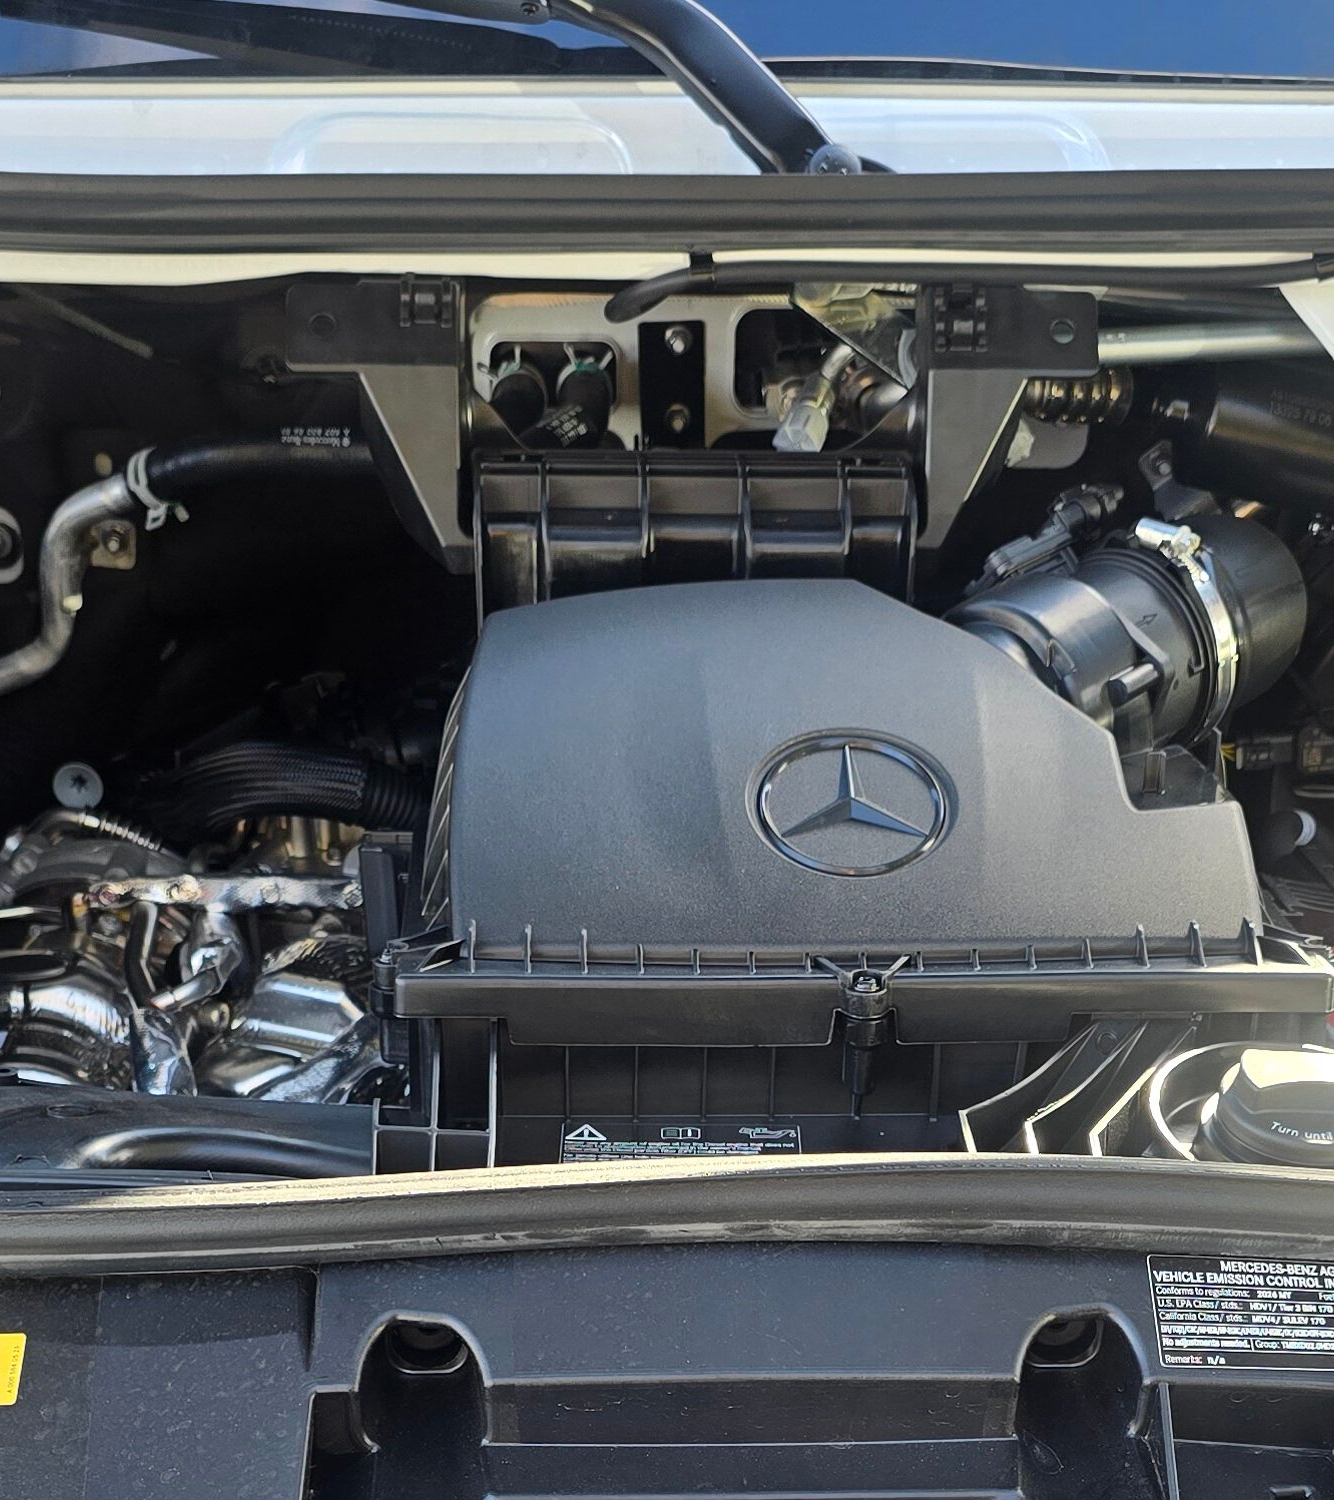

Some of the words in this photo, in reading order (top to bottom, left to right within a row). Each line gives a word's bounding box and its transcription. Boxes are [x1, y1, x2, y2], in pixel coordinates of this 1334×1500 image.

[1271, 1121, 1299, 1137] Turn
[1305, 1131, 1333, 1140] until
[1220, 1260, 1317, 1276] MERCEDES-BENZ
[1153, 1270, 1205, 1283] VEHICLE
[1206, 1272, 1265, 1286] EMISSION
[1266, 1275, 1324, 1288] CONTROL
[1156, 1286, 1194, 1295] Conforms
[1195, 1287, 1204, 1295] to
[1205, 1289, 1250, 1298] regulations:
[1177, 1299, 1192, 1308] EPA
[1159, 1312, 1197, 1320] California
[1163, 1338, 1174, 1346] No
[1165, 1354, 1202, 1364] Remarks:
[1207, 1355, 1225, 1365] n/a
